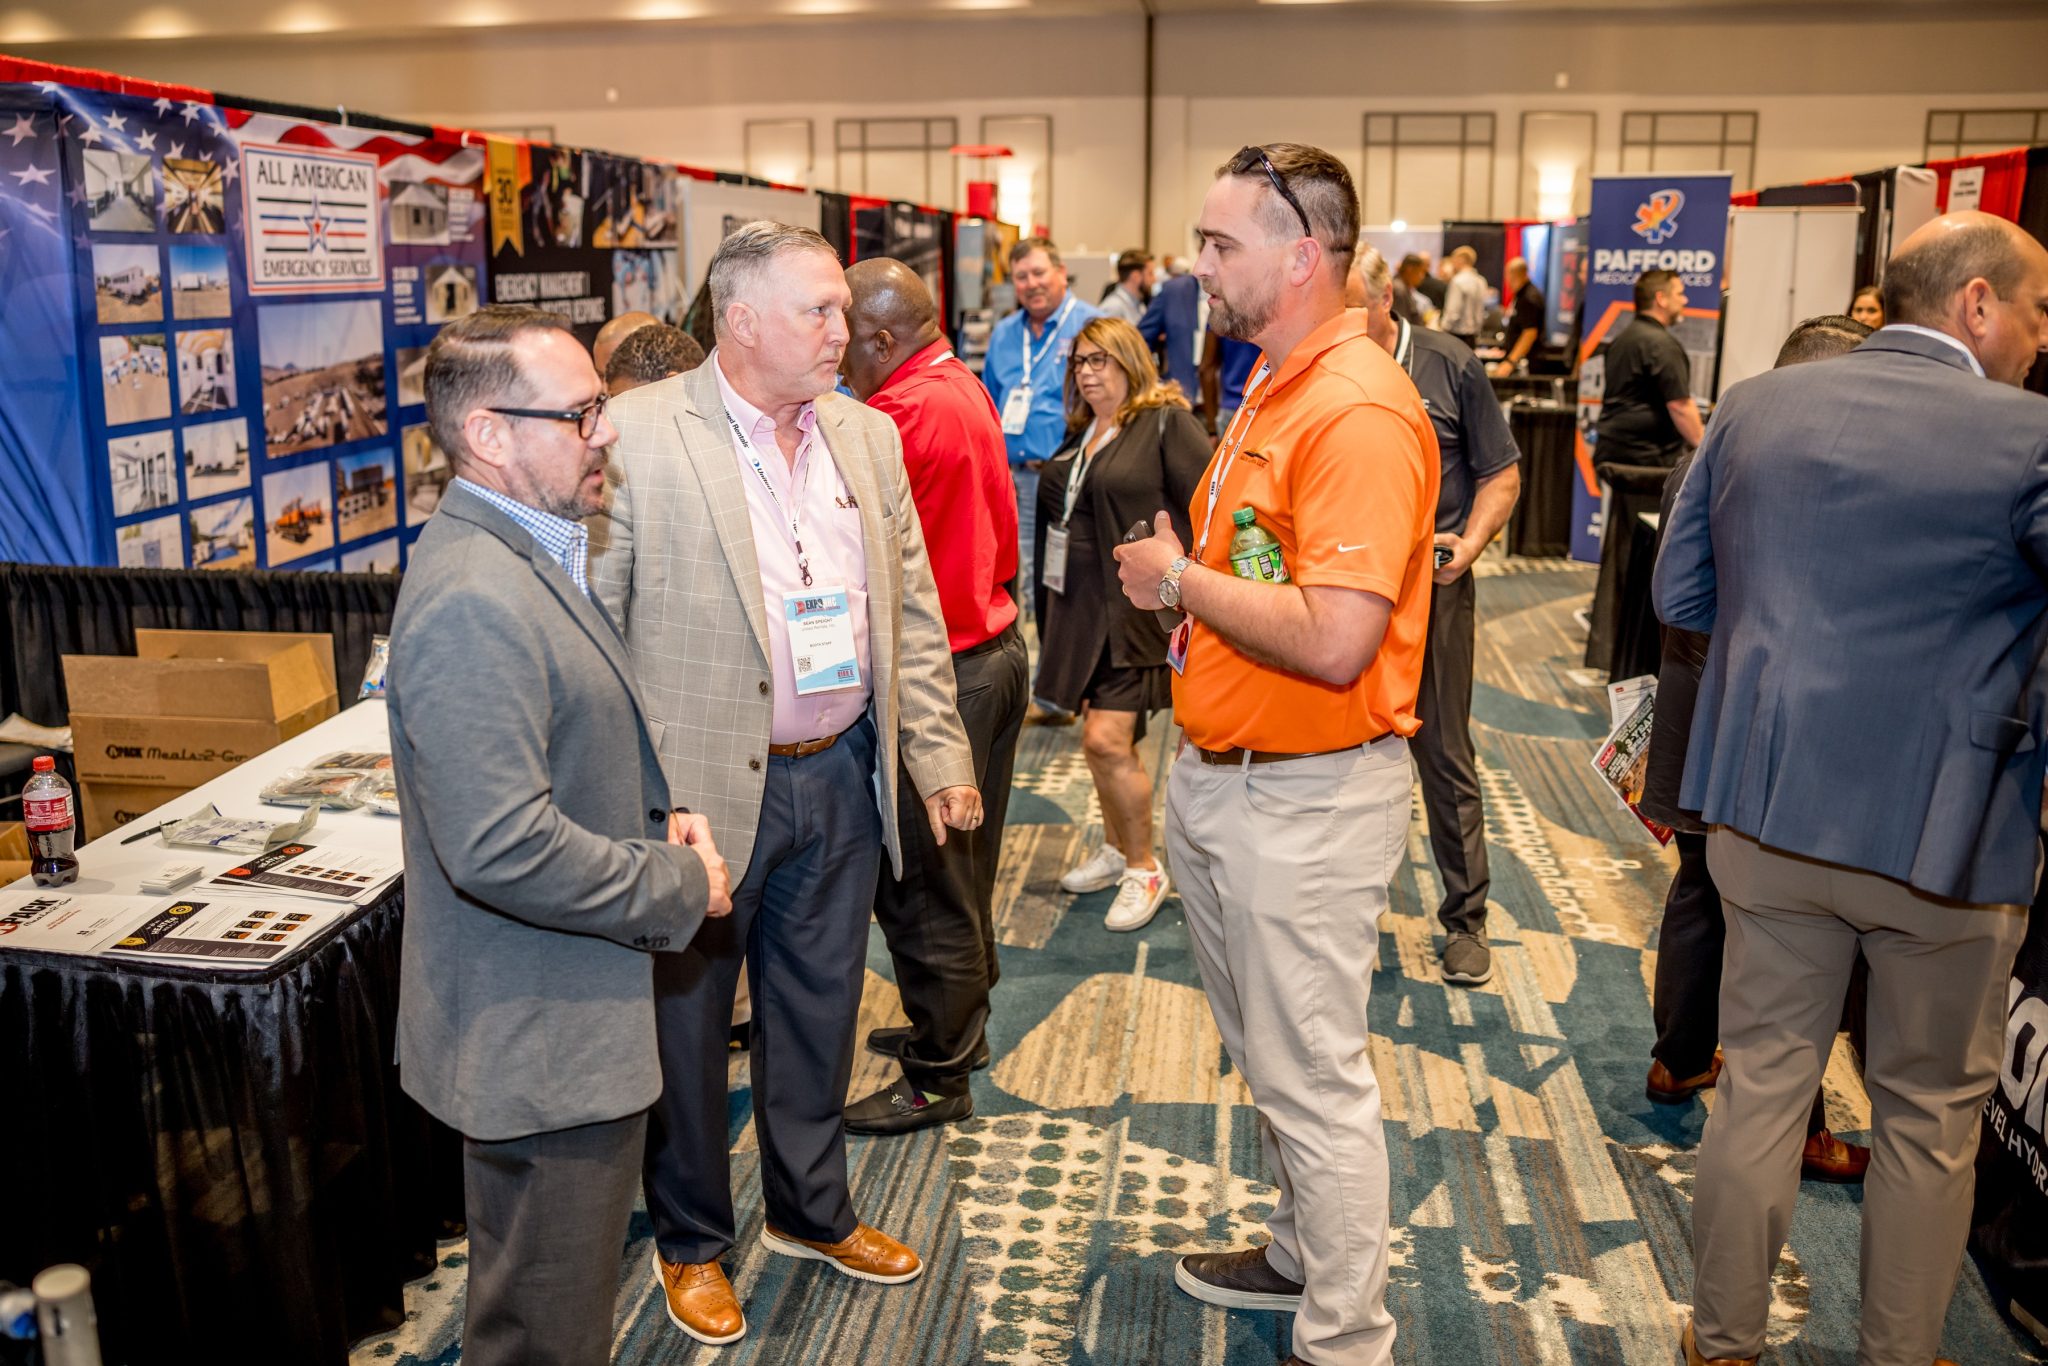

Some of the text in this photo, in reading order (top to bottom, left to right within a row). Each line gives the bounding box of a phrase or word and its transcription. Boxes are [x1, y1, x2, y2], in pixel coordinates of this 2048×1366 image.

[257, 160, 367, 192] ALL AMERICAN
[263, 258, 372, 278] EMERGENCY SERVICES
[1594, 249, 1716, 272] PAFFORD
[733, 420, 749, 448] Rentals
[1983, 1096, 2048, 1197] EVEL HYDR
